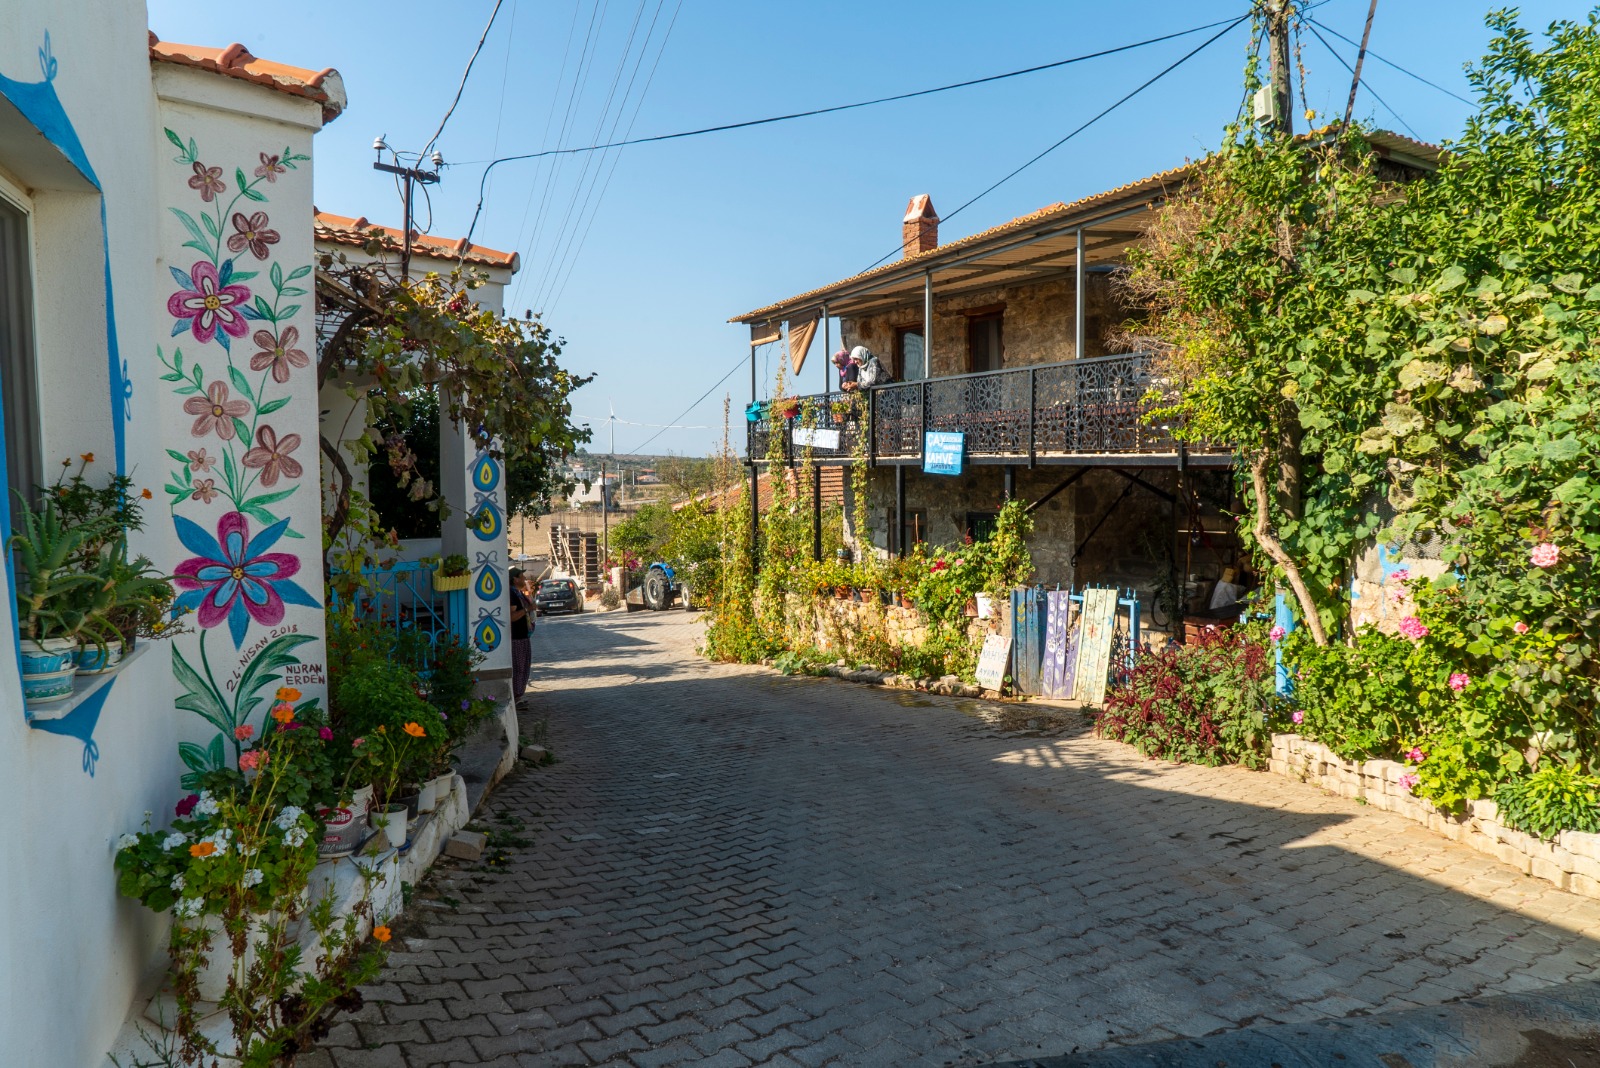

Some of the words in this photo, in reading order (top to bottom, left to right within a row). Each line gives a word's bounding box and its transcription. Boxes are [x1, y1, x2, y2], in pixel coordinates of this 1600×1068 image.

[926, 451, 953, 464] KAHVE
[270, 624, 298, 639] 2018
[286, 663, 322, 675] NURAN
[286, 674, 325, 685] ERDEN
